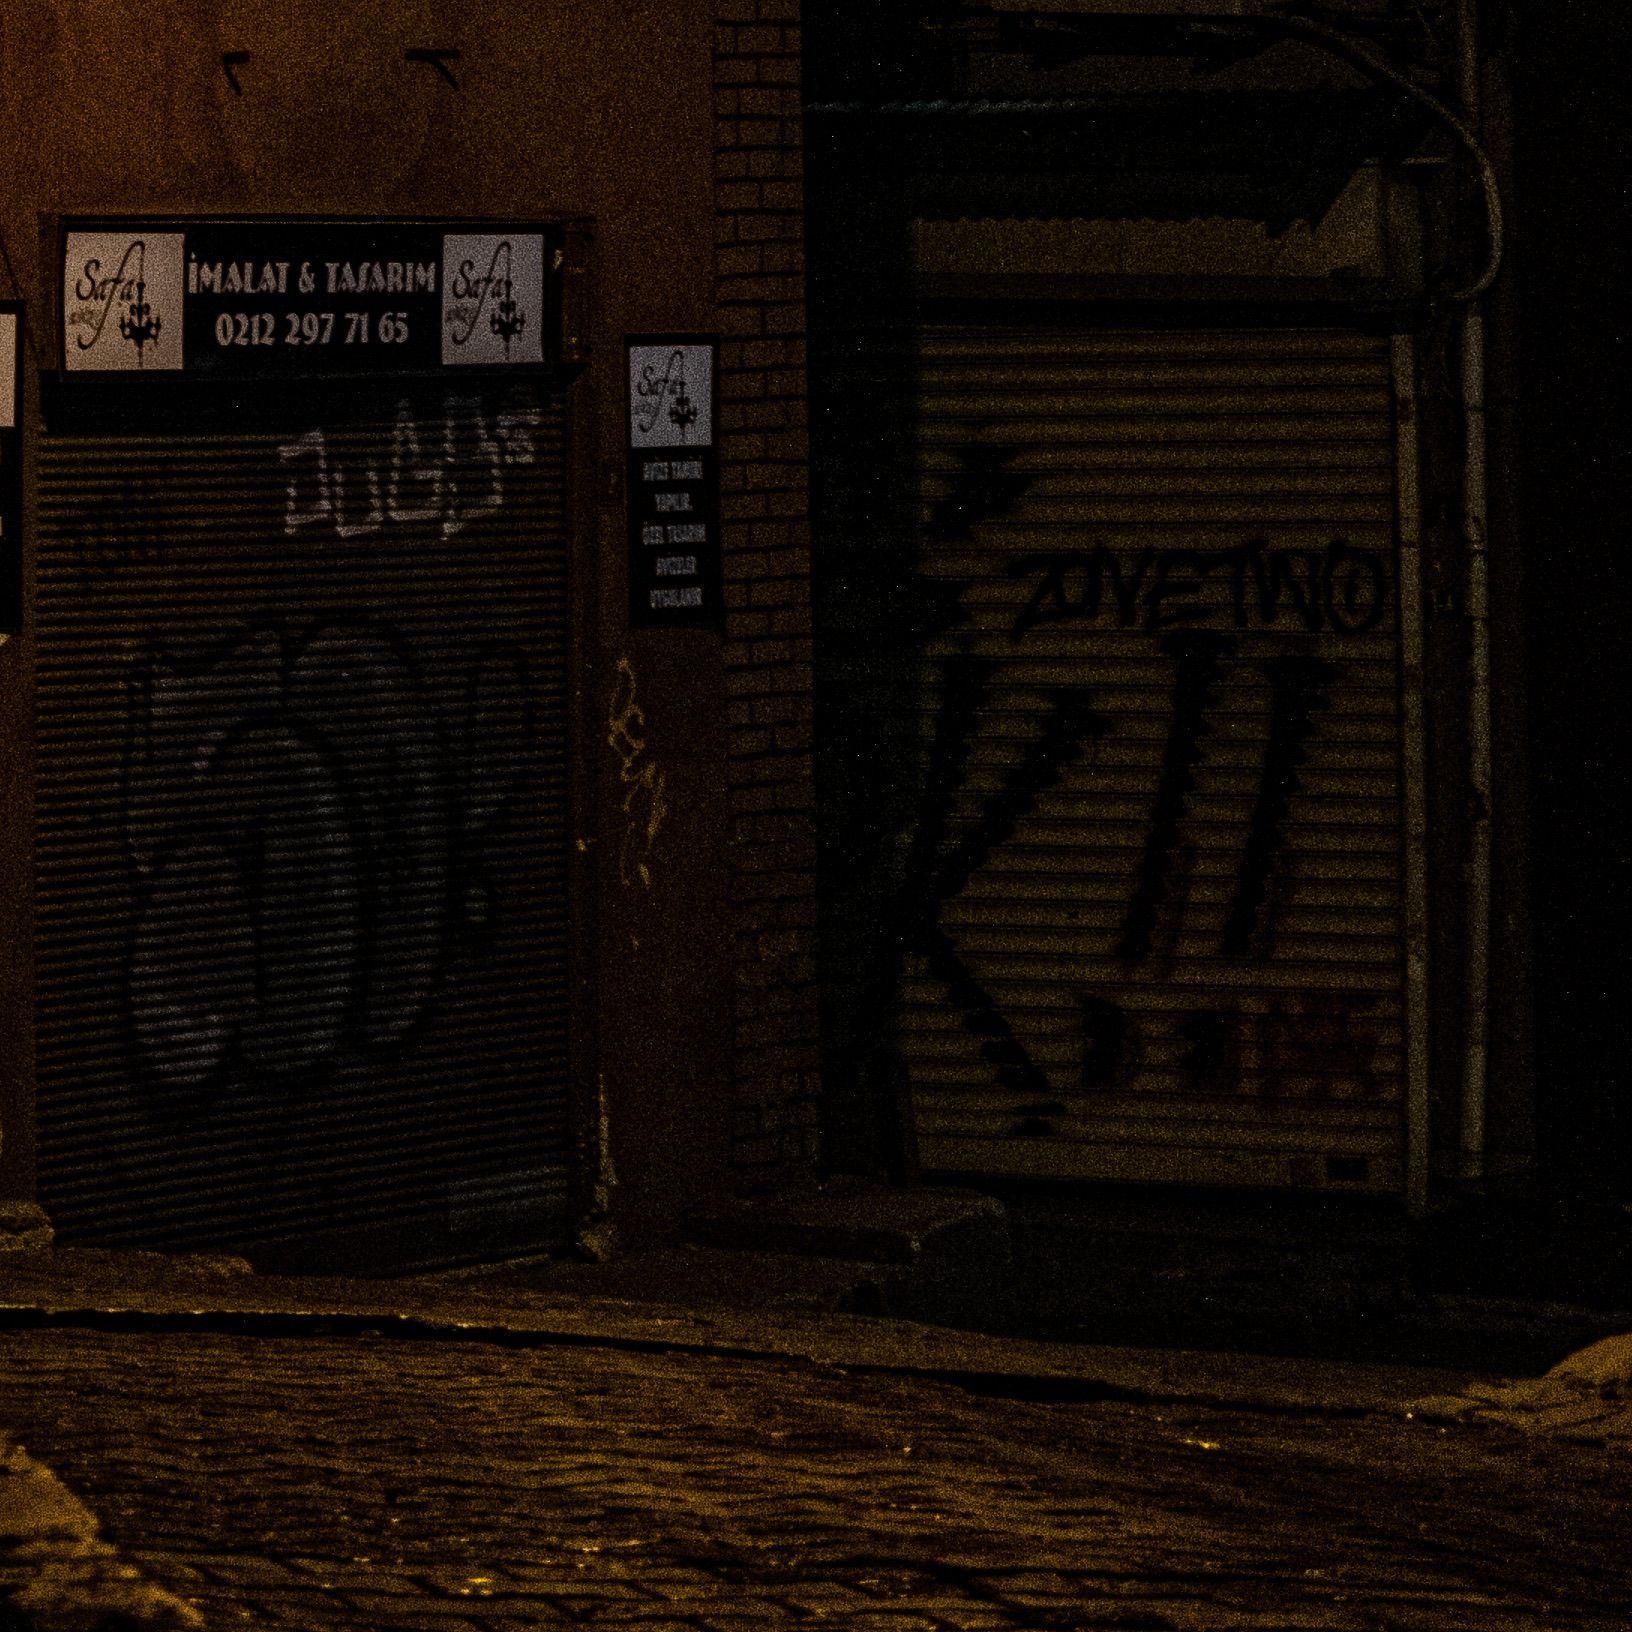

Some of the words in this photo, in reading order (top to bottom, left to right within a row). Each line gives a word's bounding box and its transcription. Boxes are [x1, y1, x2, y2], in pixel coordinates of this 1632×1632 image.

[76, 240, 145, 350] Safa
[188, 252, 290, 295] İMALAT
[297, 262, 315, 295] &
[324, 262, 437, 295] TASARIM
[451, 241, 512, 346] Safa
[216, 313, 276, 347] 0212
[284, 313, 335, 346] 297
[344, 313, 370, 345] 71
[378, 312, 409, 344] 65
